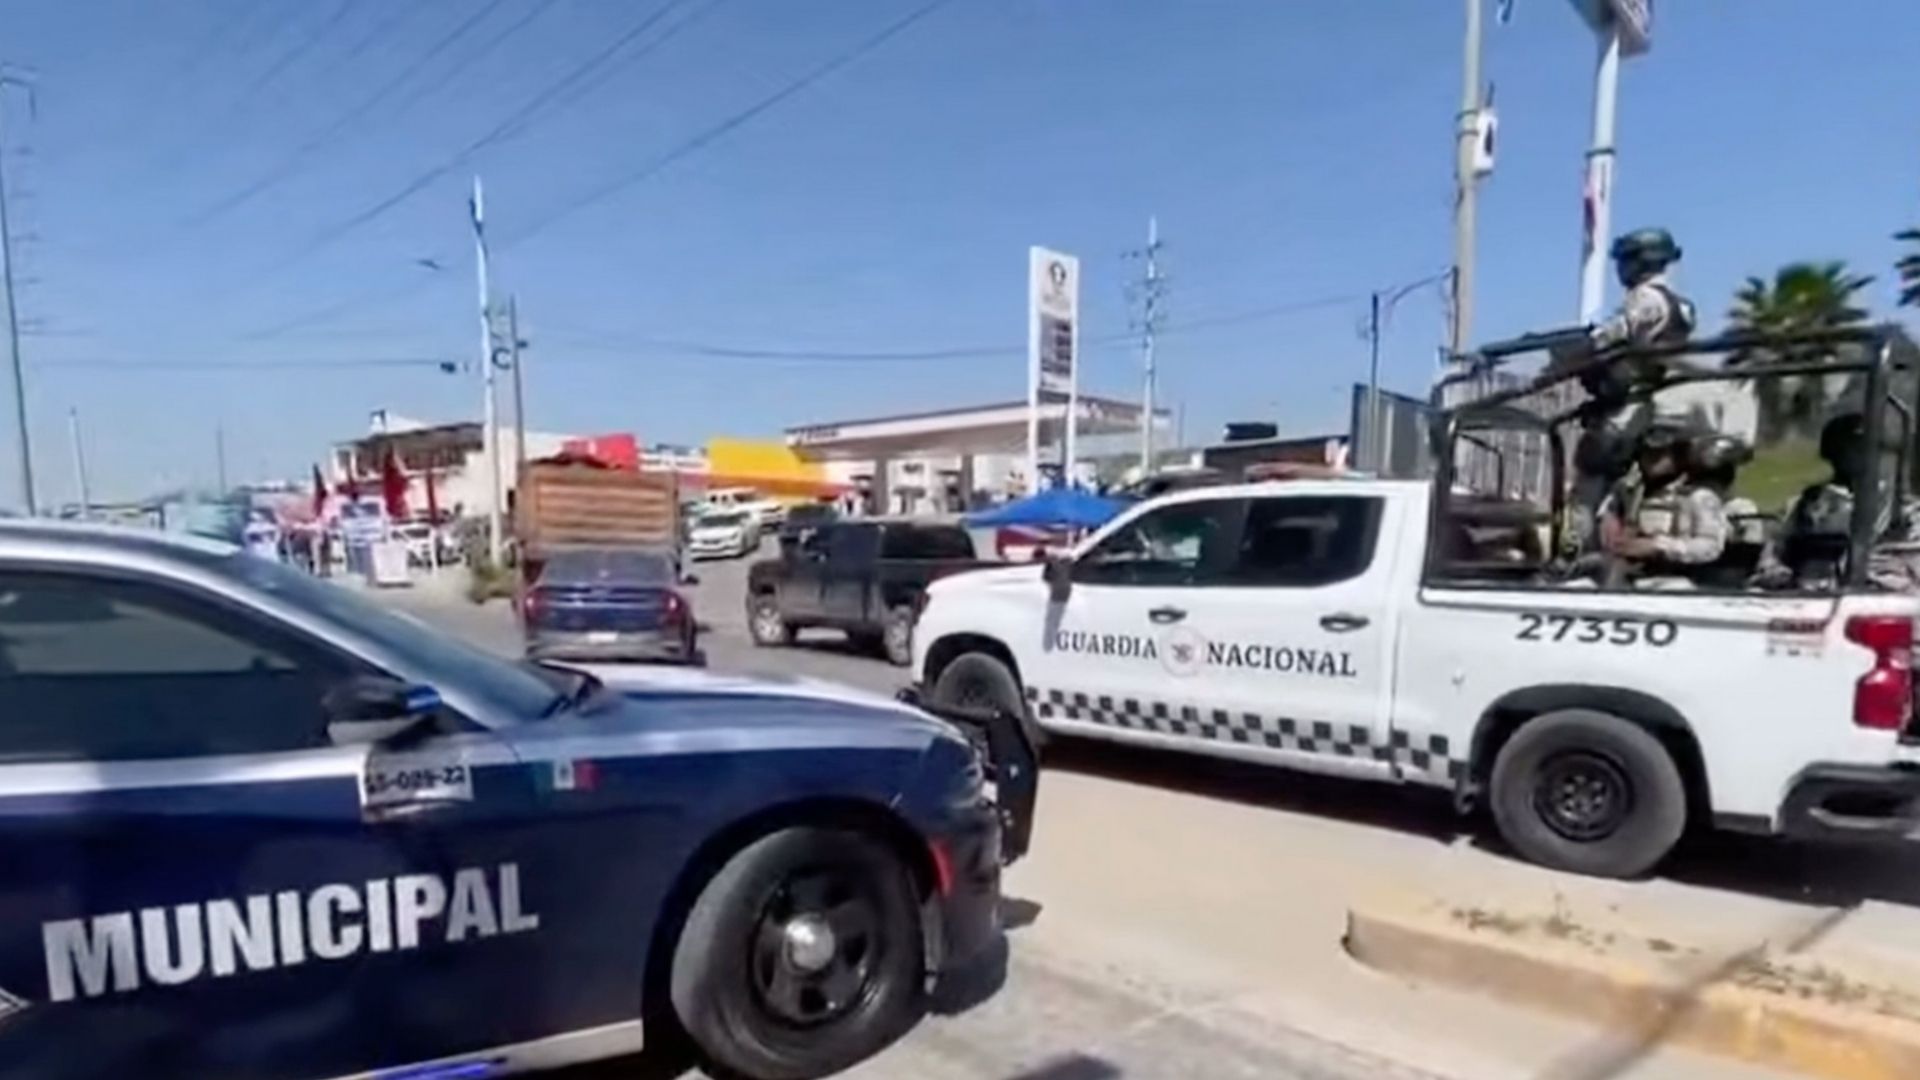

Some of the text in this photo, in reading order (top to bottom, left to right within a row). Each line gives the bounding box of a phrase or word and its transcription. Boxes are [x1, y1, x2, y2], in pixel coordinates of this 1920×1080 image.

[1516, 612, 1678, 647] 27350
[1055, 630, 1357, 677] GUARDIA NACIONAL
[42, 862, 540, 1002] MUNICIPAL
